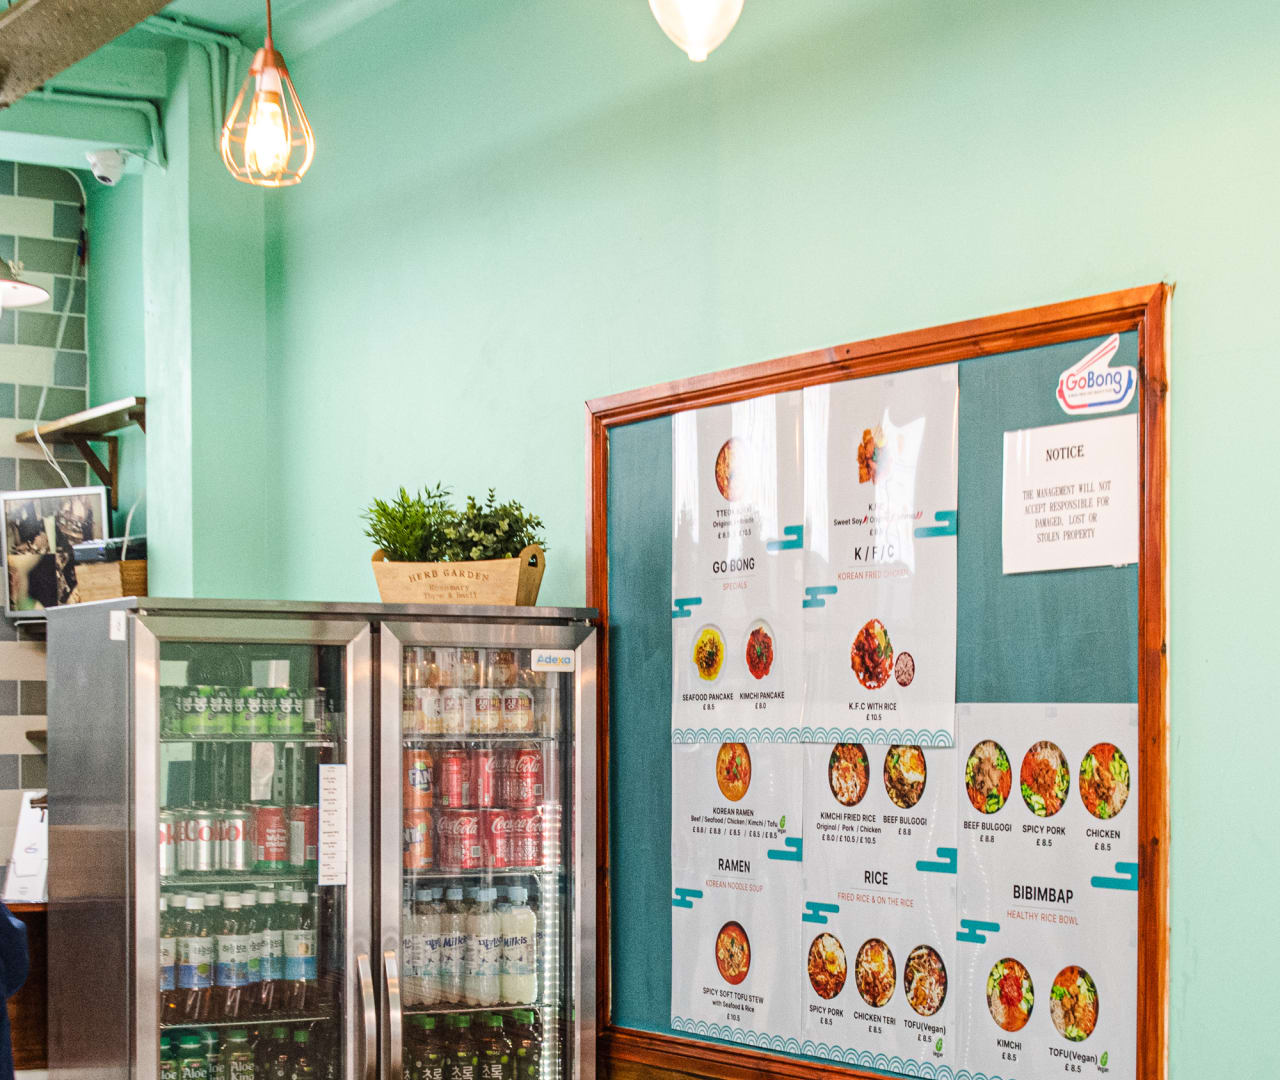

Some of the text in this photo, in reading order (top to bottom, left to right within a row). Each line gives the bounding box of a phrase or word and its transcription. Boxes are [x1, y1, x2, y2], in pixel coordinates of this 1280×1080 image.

[1066, 371, 1122, 394] GoBong
[1046, 445, 1084, 461] NOTICE
[1023, 480, 1111, 500] THE MANAGEMENT WILL NOT
[1024, 496, 1110, 514] ACCEPT RESPONSIBLE FOR
[834, 518, 850, 526] Sweet
[852, 517, 862, 526] Soy
[1069, 514, 1085, 525] LOST
[1089, 512, 1098, 523] OR
[1037, 528, 1096, 543] STOLEN PROPERTY
[855, 547, 861, 560] K
[713, 558, 755, 573] GO BONG
[409, 569, 489, 583] HERB GARDEN
[838, 572, 864, 581] KOREAN
[866, 570, 880, 579] FRIED
[723, 582, 748, 591] SPECIALS
[682, 693, 734, 701] SEAFOOD PANCAKE
[740, 691, 785, 700] KIMCHI PANCAKE
[849, 702, 897, 711] K.F.C WITH RICE
[713, 807, 754, 816] KOREAN RAMEN
[821, 812, 876, 822] KIMCHI FRIED RICE
[727, 817, 745, 825] Chicken
[748, 819, 763, 827] Kimchi
[883, 815, 927, 826] BEEF BULGOGI
[963, 821, 1012, 832] BEEF BULGOGI
[816, 823, 881, 834] Original Pork Chicken
[1022, 825, 1066, 835] SPICY PORK
[1086, 829, 1120, 839] CHICKEN
[844, 835, 855, 843] 10.5
[1100, 843, 1111, 851] 8.5
[718, 858, 750, 872] RAMEN
[864, 870, 888, 885] RICE
[706, 880, 763, 892] KOREAN NOODLE SOUP
[837, 892, 854, 902] FRIED
[856, 894, 870, 903] RICE
[877, 896, 886, 904] ON
[888, 897, 899, 906] THE
[900, 898, 914, 908] RICE
[1013, 884, 1074, 904] BIBIMBAP
[1007, 910, 1079, 925] HEALTHY RICE BOWL
[702, 987, 764, 1004] SPICY SOFT TOFU STEW
[723, 1001, 740, 1010] Seafood
[745, 1005, 755, 1013] Rice
[809, 1005, 844, 1017] SPICY PORK
[853, 1011, 896, 1025] CHICKEN TERI
[904, 1020, 946, 1035] TOFU(Vegan)
[997, 1038, 1021, 1051] KIMCHI
[1007, 1053, 1017, 1061] 8.5
[1049, 1047, 1098, 1065] TOFU(Vegan)
[231, 1061, 254, 1072] Aloe
[451, 1065, 474, 1080] 초록
[482, 1064, 503, 1079] 초록
[1070, 1064, 1082, 1073] 8.5
[161, 1070, 177, 1080] loe
[183, 1068, 207, 1078] Aloe
